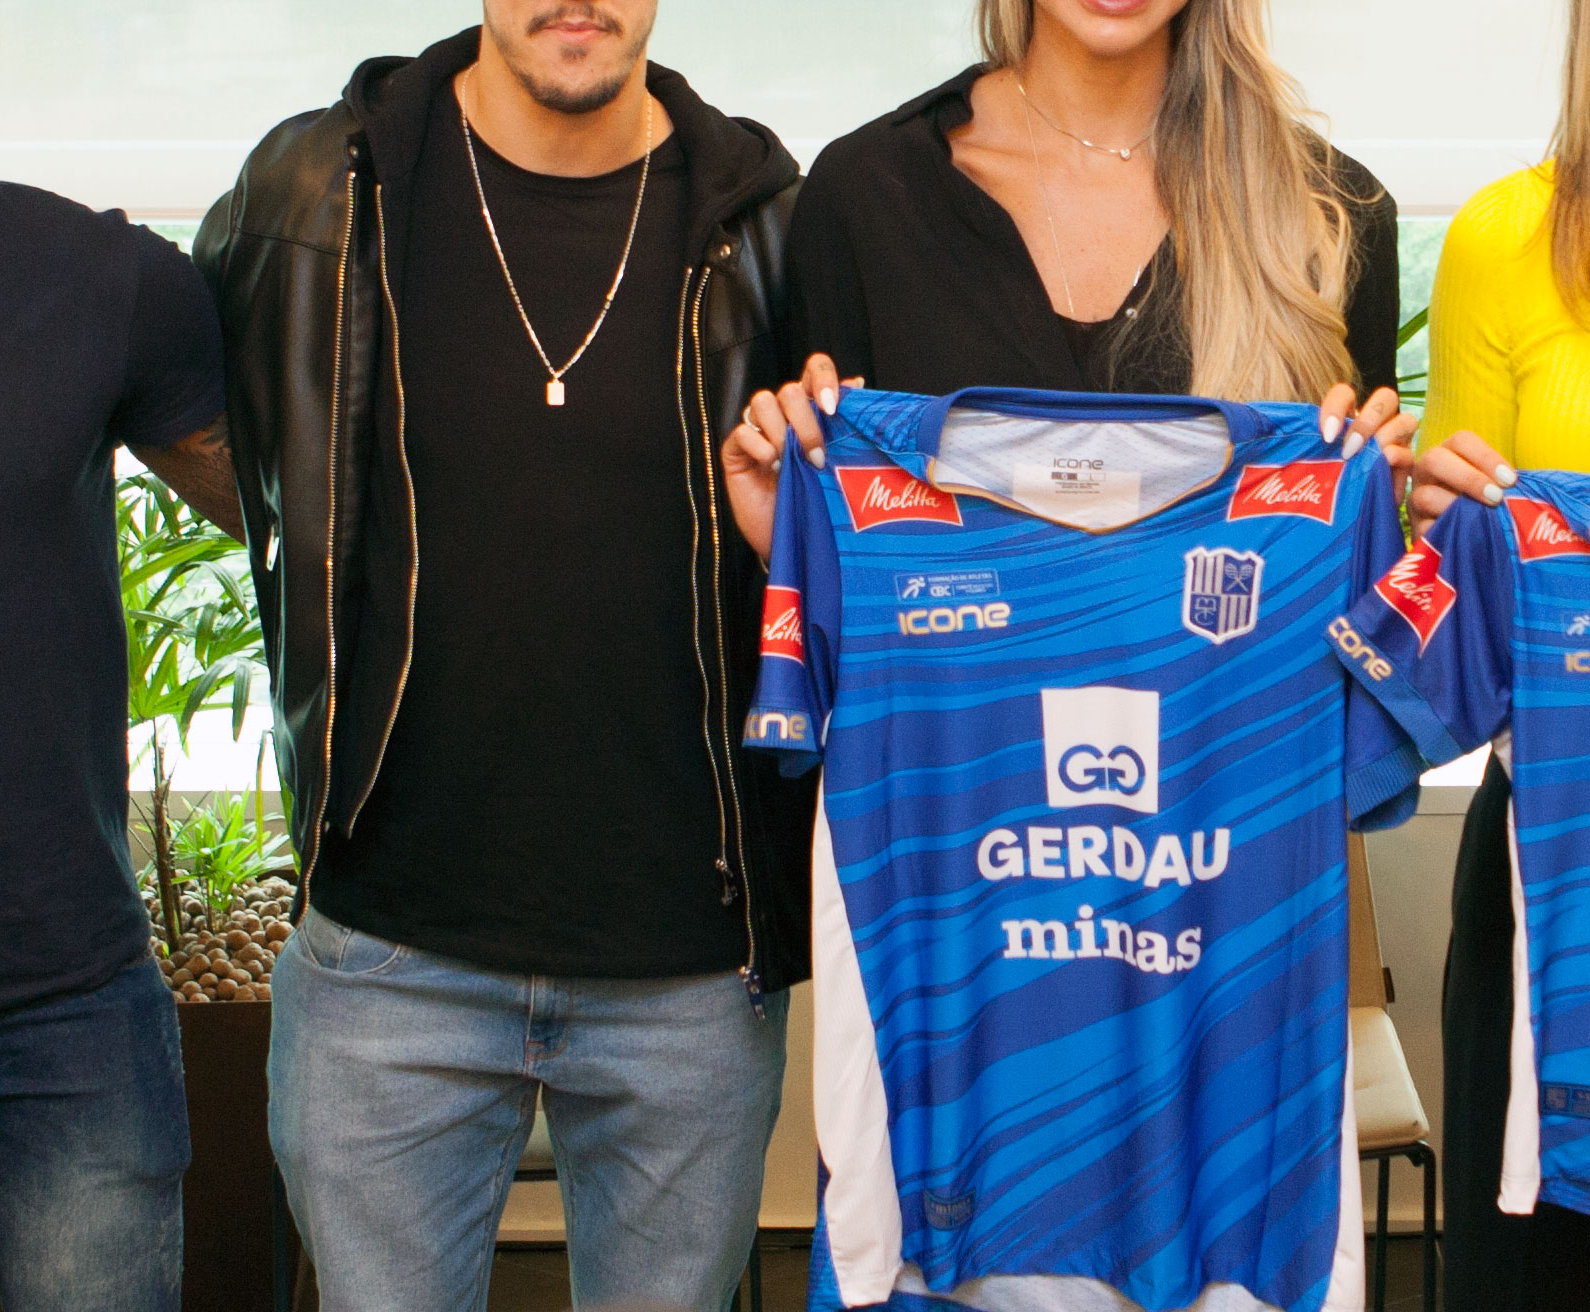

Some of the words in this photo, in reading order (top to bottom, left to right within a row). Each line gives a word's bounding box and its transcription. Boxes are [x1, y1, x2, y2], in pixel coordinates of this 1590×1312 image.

[1053, 458, 1105, 470] icone
[860, 476, 941, 513] Melitta
[1242, 471, 1323, 504] Melitta
[898, 602, 1011, 636] icone
[977, 825, 1230, 889] GERDAU
[1000, 904, 1203, 975] minas
